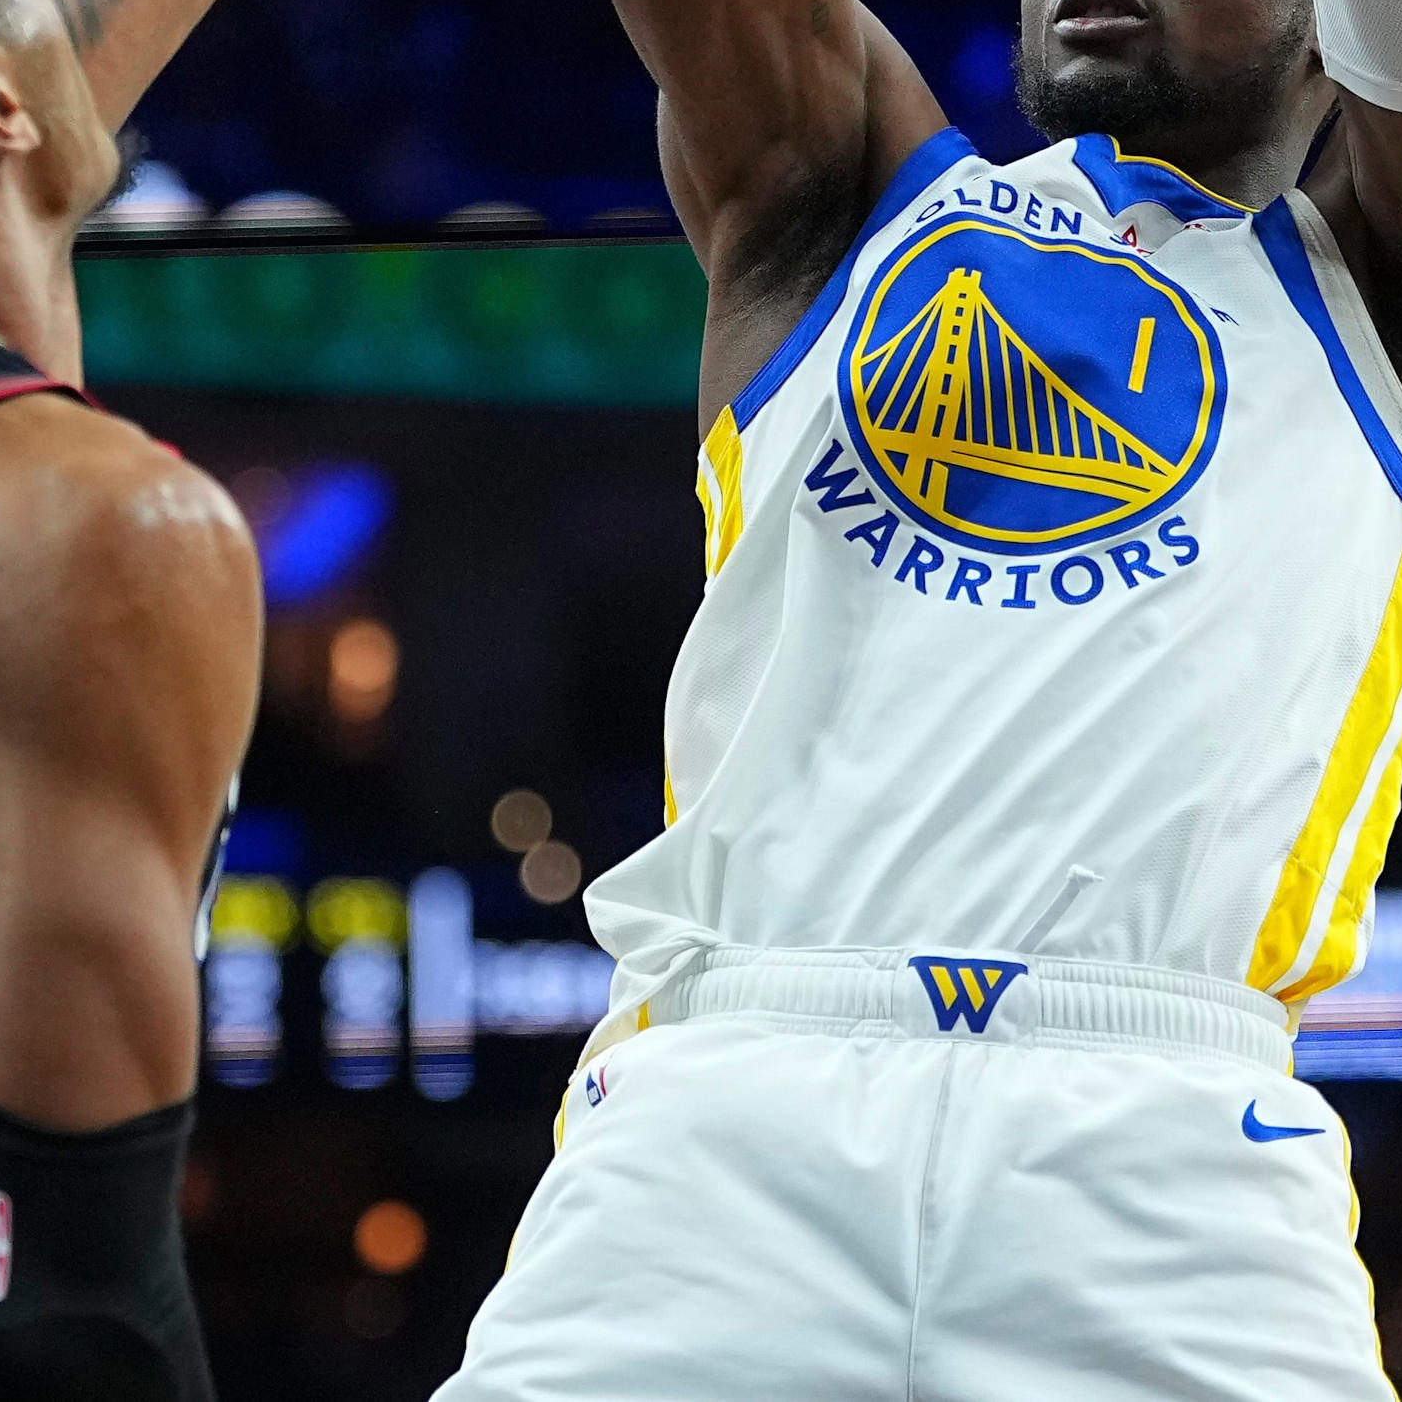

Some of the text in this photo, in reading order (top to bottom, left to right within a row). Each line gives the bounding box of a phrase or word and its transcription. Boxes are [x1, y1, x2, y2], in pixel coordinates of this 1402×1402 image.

[903, 179, 1082, 237] OLDEN
[1127, 317, 1155, 393] 1
[803, 439, 1200, 609] WARRIORS
